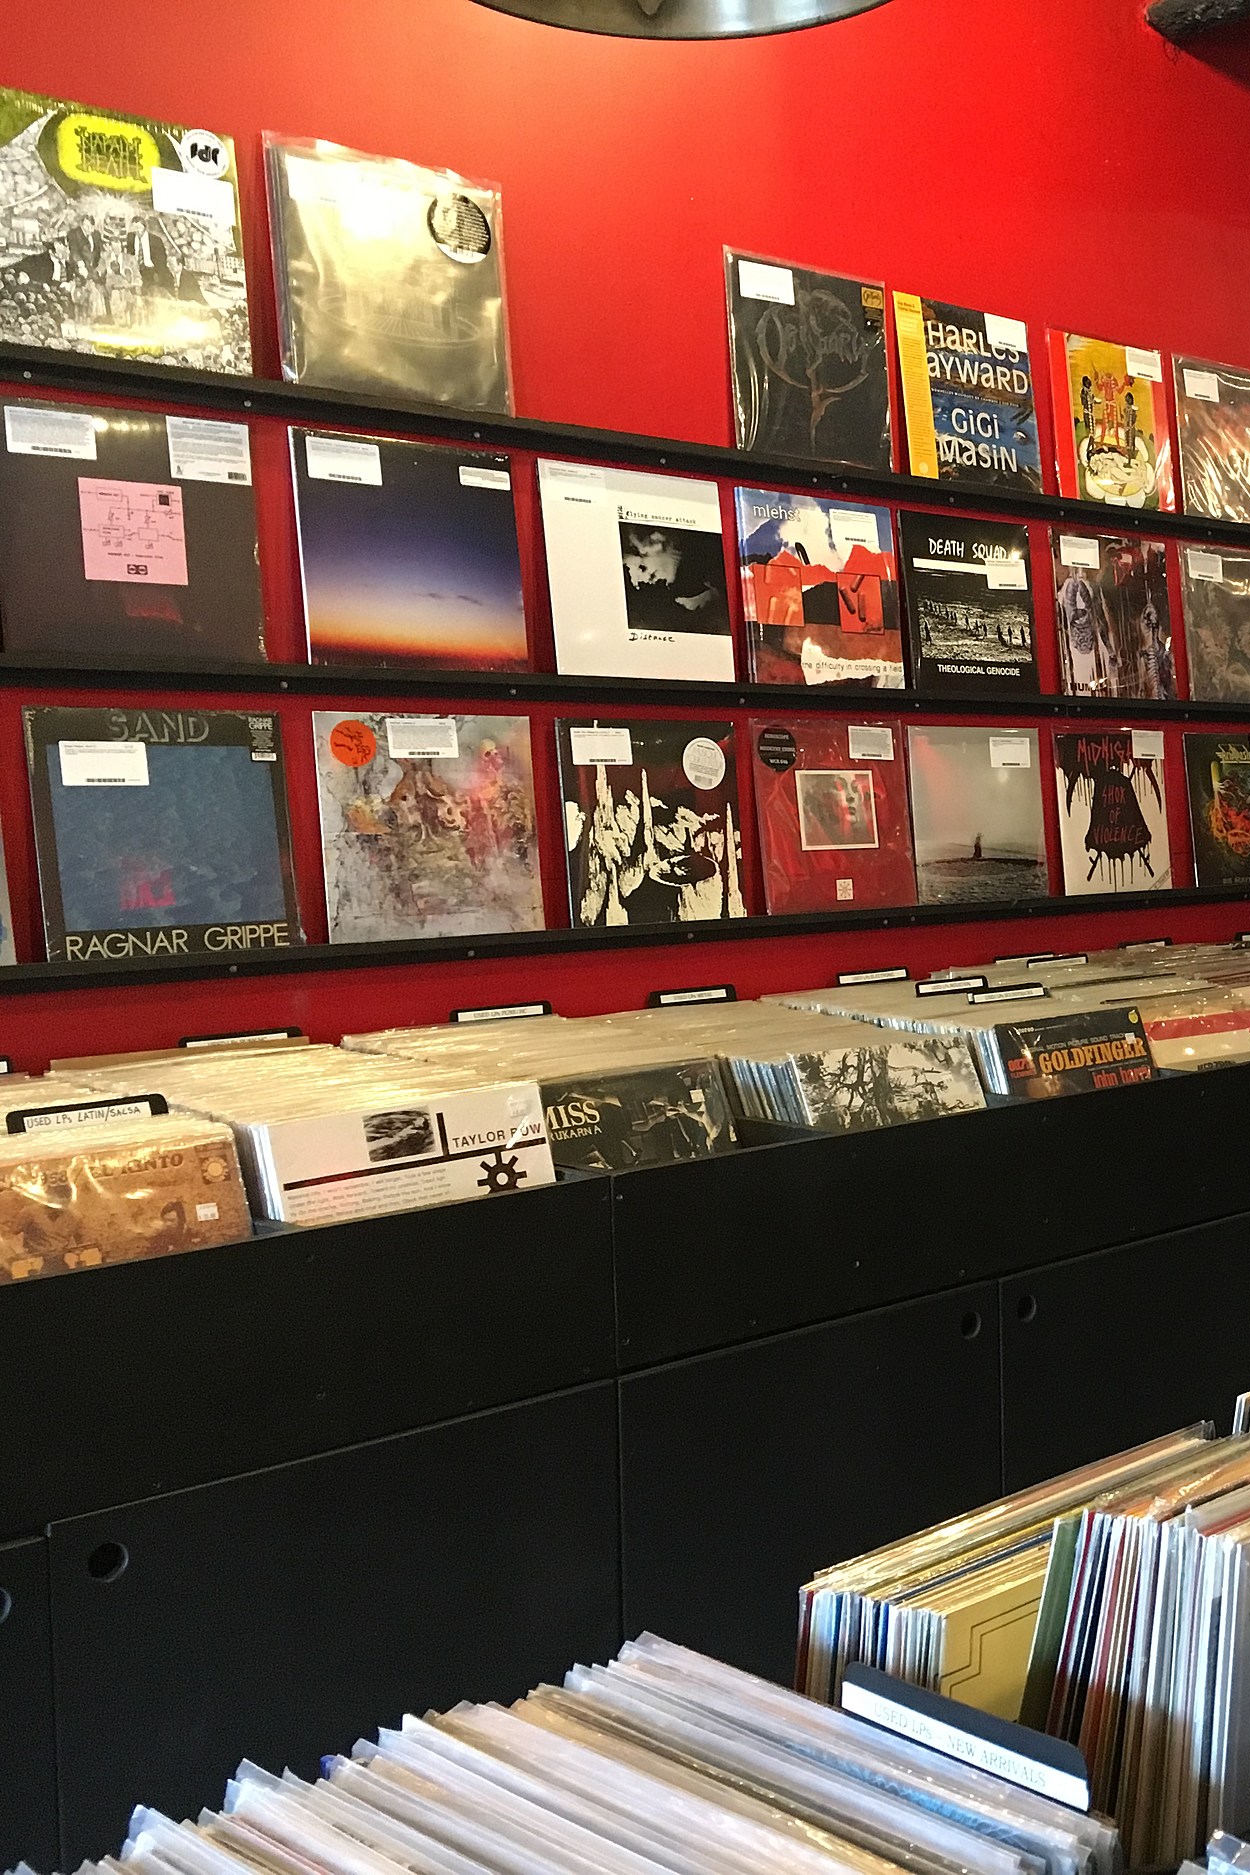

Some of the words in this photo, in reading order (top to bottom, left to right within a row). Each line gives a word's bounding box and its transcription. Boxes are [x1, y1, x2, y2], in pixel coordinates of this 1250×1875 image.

[950, 407, 1001, 440] GiGi
[753, 505, 801, 523] mlehst
[928, 537, 965, 558] DEATH
[972, 542, 1008, 561] SQUAD
[815, 662, 845, 673] difficulty
[855, 664, 881, 674] crossing
[937, 663, 985, 676] THEOLOGICAL
[986, 666, 1021, 677] GENOCIDE
[106, 711, 210, 744] SAND
[1077, 736, 1132, 776] MIDNIG
[1109, 808, 1121, 824] OF
[1094, 824, 1145, 846] VIOLENCE
[65, 929, 190, 961] RAGNAR
[203, 922, 291, 952] GRIPPE
[1038, 1037, 1148, 1074] GOLDFINGER
[27, 1114, 52, 1129] USED
[56, 1112, 72, 1125] LPs
[77, 1105, 141, 1122] LATIN/SALSA
[452, 1129, 505, 1149] TAYLOR
[873, 1702, 908, 1729] USED
[948, 1735, 977, 1758] NEW
[980, 1749, 1047, 1788] ARRIVALS
